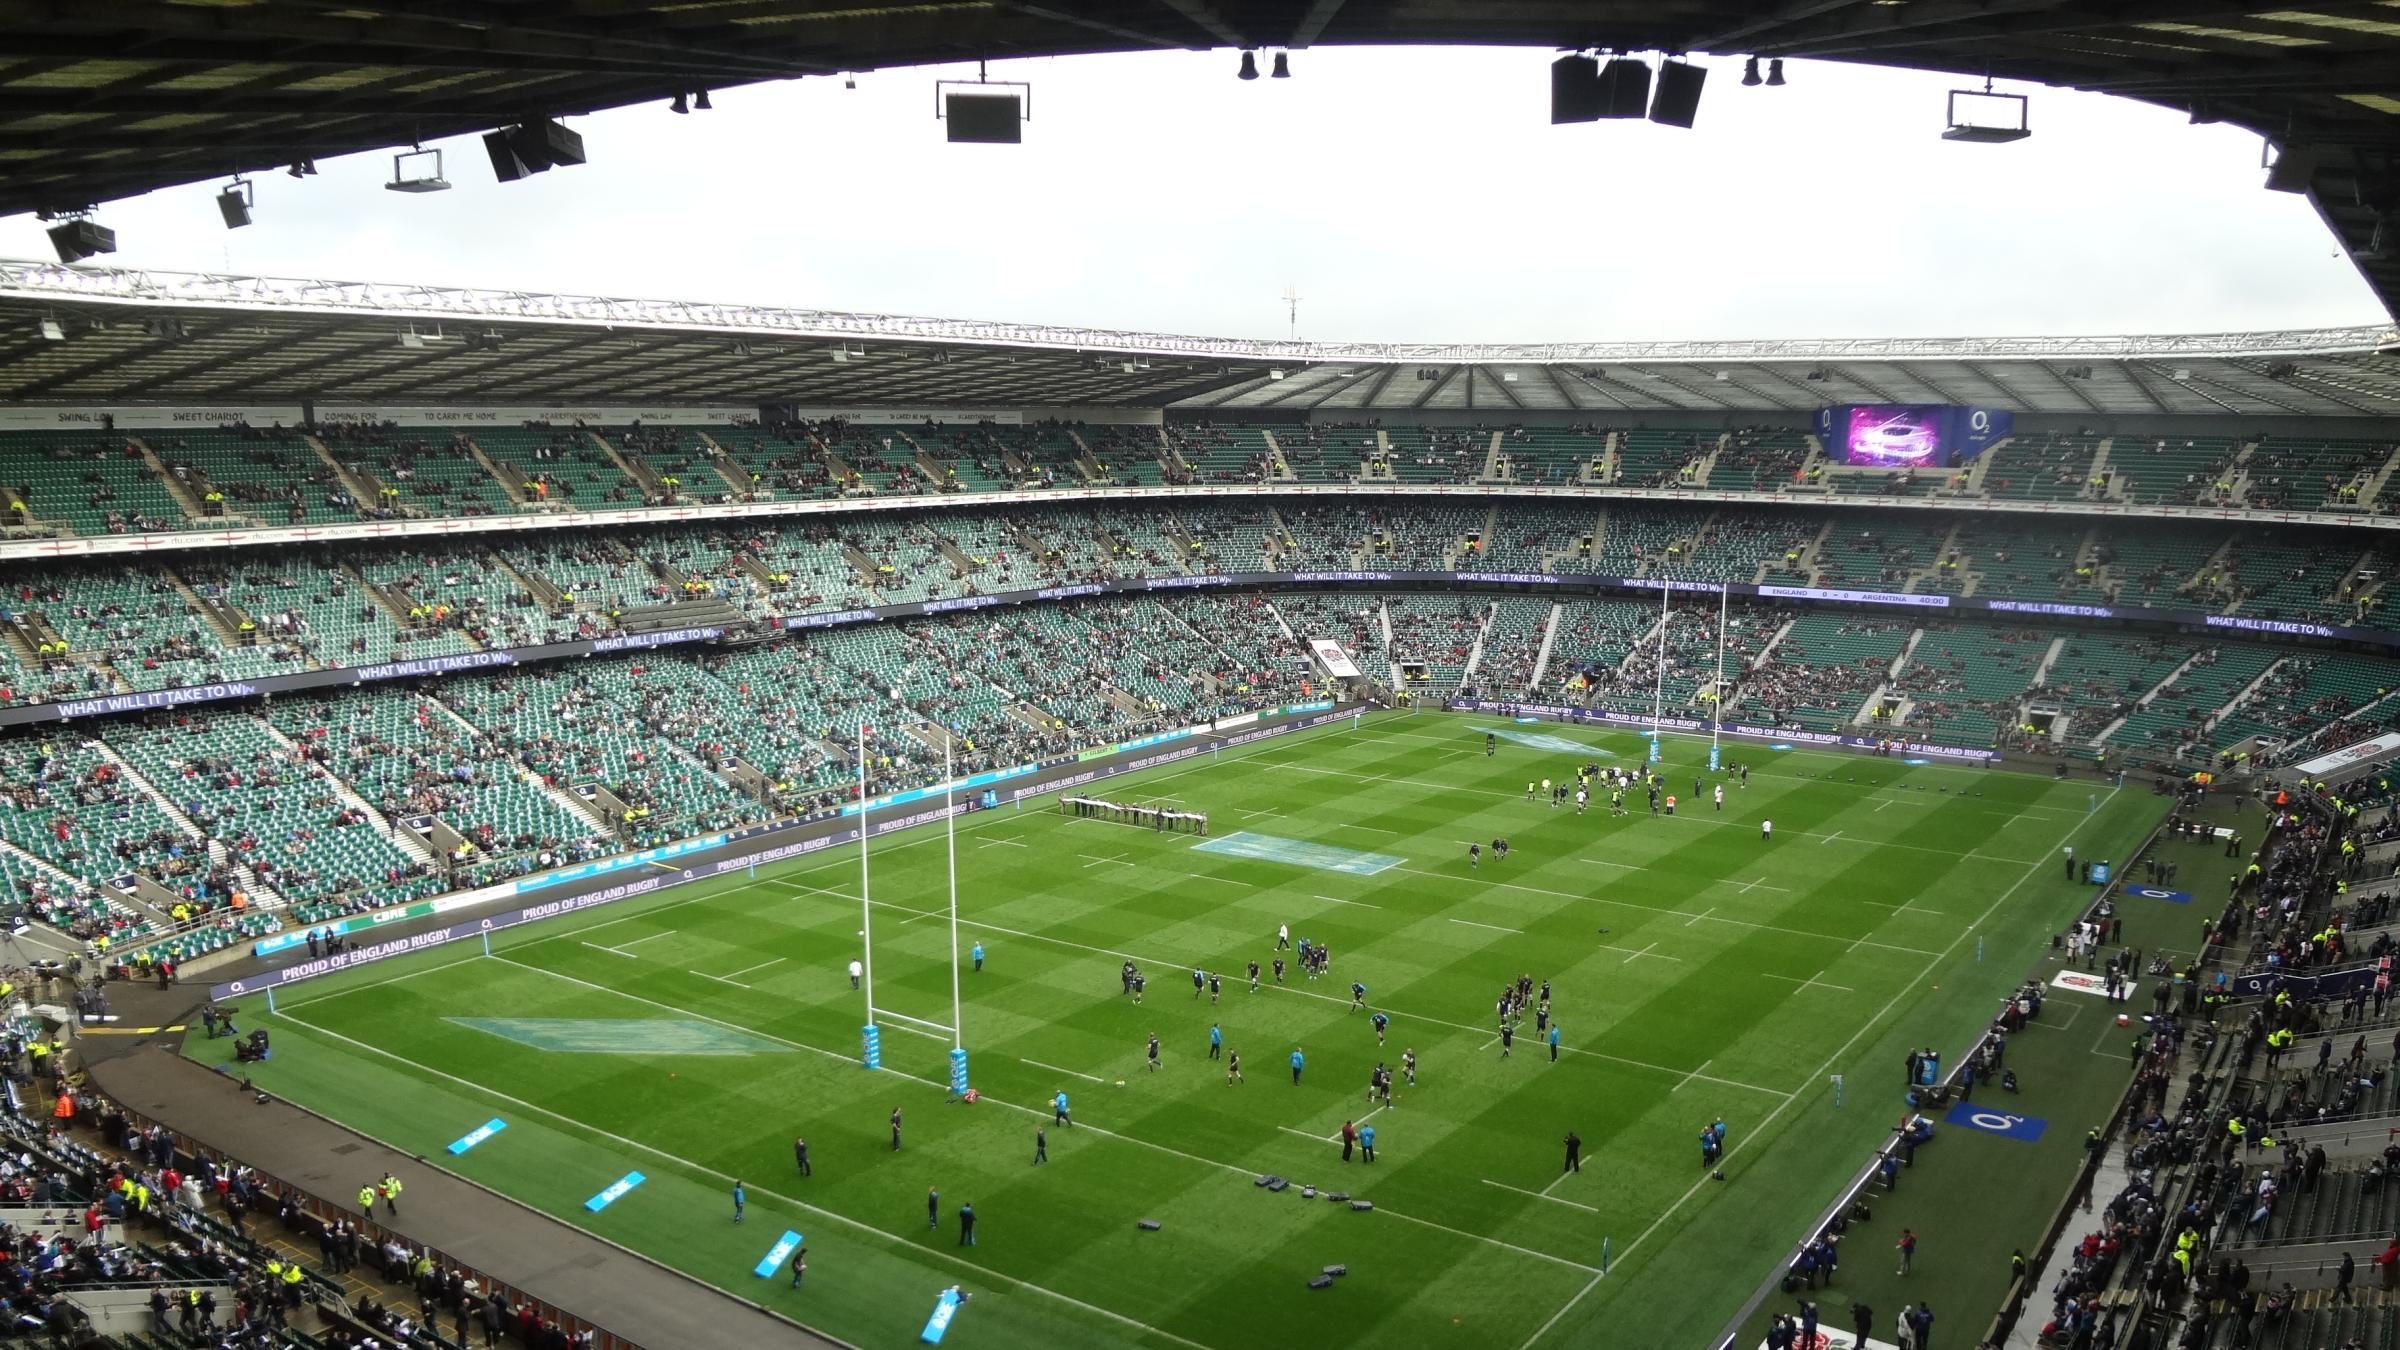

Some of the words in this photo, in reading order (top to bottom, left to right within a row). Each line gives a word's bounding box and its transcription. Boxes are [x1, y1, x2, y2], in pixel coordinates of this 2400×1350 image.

[58, 412, 91, 423] SWING
[173, 412, 202, 421] SWEET
[206, 412, 245, 421] CHARIOT
[325, 412, 358, 422] COMING
[361, 412, 377, 422] FOR
[425, 413, 434, 421] TO
[437, 413, 461, 421] CARRY
[477, 413, 498, 421] HOME
[1972, 410, 1991, 434] O2
[1147, 578, 1165, 588] WHAT
[1167, 578, 1183, 586] WILL
[1184, 577, 1191, 586] IT
[1192, 577, 1208, 585] TAKE
[1209, 576, 1218, 584] TO
[1344, 572, 1363, 580] TAKE
[1364, 572, 1375, 580] TO
[1457, 573, 1479, 581] WHAT
[1481, 573, 1499, 581] WILL
[1501, 573, 1508, 581] IT
[1510, 574, 1529, 582] TAKE
[1623, 578, 1644, 588] WHAT
[1646, 579, 1664, 588] WILL
[1666, 580, 1673, 589] T
[1676, 581, 1695, 590] TAKE
[1697, 582, 1707, 591] TO
[923, 601, 940, 611] WHAT
[942, 600, 955, 610] WILL
[964, 598, 978, 608] TAKE
[1773, 588, 1808, 598] ENGLAND
[1862, 593, 1907, 603] ARGENTINA
[1920, 596, 1945, 605] 40:00
[1989, 600, 2016, 610] WHAT
[2017, 601, 2041, 612] WILL
[2042, 604, 2051, 613] IT
[2053, 604, 2078, 614] TAKE
[2079, 605, 2092, 615] TO
[788, 615, 808, 628] WHAT
[810, 613, 826, 626] WILL
[836, 611, 851, 622] TAKE
[852, 610, 862, 620] TO
[2206, 616, 2233, 627] WHAT
[2235, 617, 2260, 629] WILL
[2261, 620, 2272, 630] IT
[2273, 621, 2298, 633] TAKE
[2300, 623, 2315, 635] TO
[594, 638, 624, 651] WHAT
[626, 635, 649, 648] WILL
[651, 633, 661, 644] IT
[662, 630, 686, 643] TAKE
[688, 629, 701, 640] TO
[358, 665, 396, 680] WHAT
[398, 661, 428, 676] WILL
[429, 658, 441, 672] IT
[442, 655, 473, 670] TAKE
[475, 653, 490, 665] TO
[58, 700, 104, 717] WHAT
[107, 694, 146, 712] WILL
[149, 691, 162, 706] IT
[165, 686, 203, 705] TAKE
[204, 684, 226, 700] TO
[1606, 712, 1629, 721] PROUD
[1631, 714, 1641, 722] OF
[1676, 719, 1702, 729] RUGBY
[1227, 734, 1244, 745] PROUD
[1251, 727, 1272, 740] ENGLAND
[1273, 723, 1287, 735] RUGBY
[1737, 725, 1763, 735] PROUD
[1764, 727, 1775, 736] OF
[1776, 729, 1812, 740] ENGLAND
[1814, 733, 1842, 743] RUGBY
[1129, 758, 1147, 769] PROUD
[1148, 756, 1156, 766] OF
[1157, 750, 1180, 764] ENGLAND
[1181, 746, 1198, 758] RUGBY
[1880, 740, 1909, 749] POU
[1911, 743, 1921, 751] OF
[1922, 744, 1960, 755] ENGLAND
[1962, 748, 1993, 758] RUGBY
[1037, 781, 1045, 793] OF
[1046, 774, 1074, 790] ENGLAND
[1075, 771, 1094, 784] RUGBY
[879, 817, 904, 832] PROUD
[905, 814, 916, 826] OF
[917, 806, 949, 824] ENGLAND
[950, 800, 974, 816] UGY
[718, 856, 748, 872] PROUD
[763, 842, 802, 862] ENGLAND
[803, 836, 831, 852] RUGBY
[523, 901, 559, 920] PROUD
[561, 897, 575, 911] OF
[577, 885, 625, 906] ENGLAND
[627, 877, 660, 896] RUGBY
[373, 908, 408, 923] CBRE
[282, 959, 328, 982] PROUD
[330, 953, 347, 969] OF
[350, 939, 409, 966] ENGLAND
[411, 929, 450, 950] RUGBY
[1971, 1113, 2024, 1130] O2
